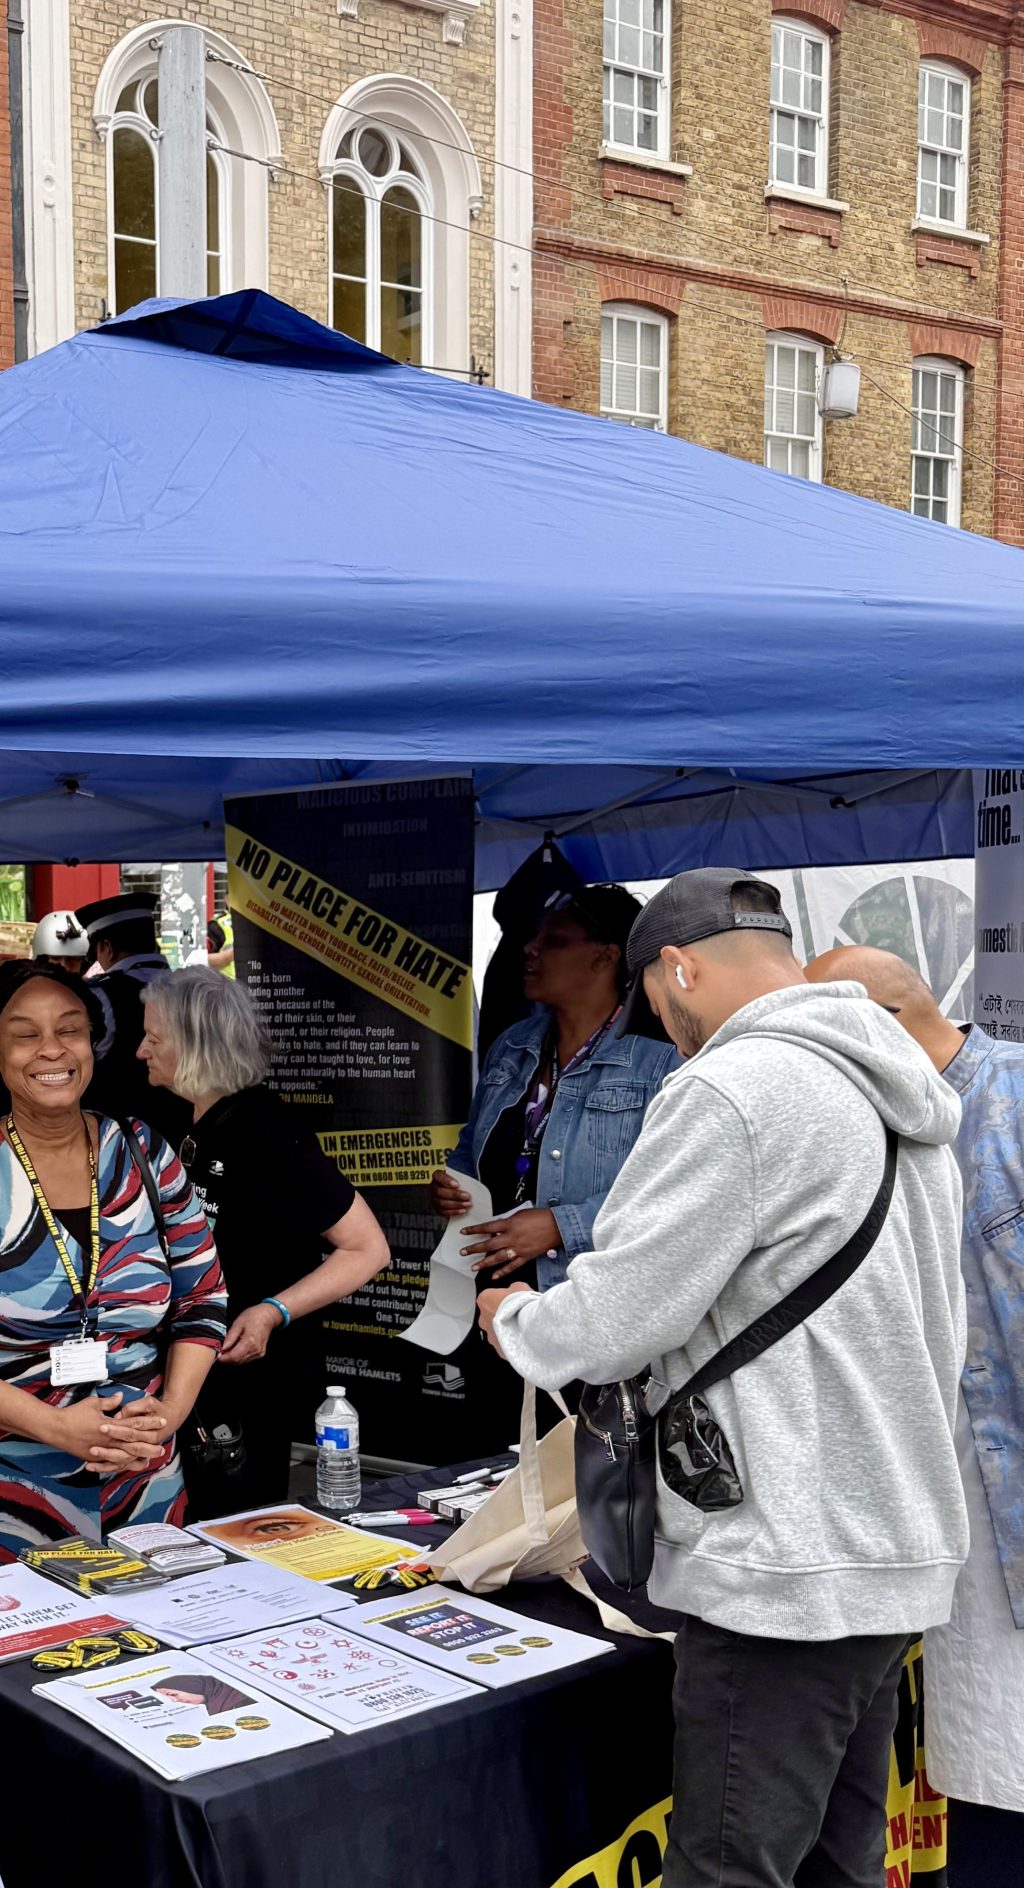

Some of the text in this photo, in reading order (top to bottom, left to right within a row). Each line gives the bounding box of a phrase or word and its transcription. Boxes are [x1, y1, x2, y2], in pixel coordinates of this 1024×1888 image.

[235, 838, 468, 999] NO PLACE FOR HATE
[308, 920, 329, 940] WHAT
[248, 973, 292, 983] one is born
[273, 987, 305, 996] another
[276, 1001, 310, 1010] because
[313, 1000, 321, 1009] of
[322, 1000, 335, 1009] the
[274, 1014, 283, 1023] of
[285, 1013, 303, 1023] their
[326, 1015, 335, 1023] or
[337, 1013, 356, 1023] their
[299, 1029, 308, 1037] or
[310, 1027, 328, 1036] their
[330, 1026, 363, 1038] religion.
[366, 1026, 395, 1037] People
[293, 1041, 301, 1049] to
[325, 1041, 340, 1050] and
[349, 1041, 368, 1052] they
[369, 1042, 385, 1050] can
[387, 1041, 409, 1050] learn
[411, 1041, 420, 1051] to
[290, 1055, 305, 1063] can
[307, 1054, 317, 1063] be
[319, 1055, 344, 1065] taught
[346, 1055, 354, 1064] to
[378, 1055, 390, 1064] for
[392, 1055, 411, 1064] love
[277, 1068, 299, 1076] more
[301, 1068, 336, 1079] naturally
[338, 1069, 346, 1077] to
[347, 1068, 361, 1077] the
[362, 1068, 392, 1078] human
[393, 1068, 416, 1079] heart
[268, 1081, 279, 1089] its
[293, 1094, 334, 1104] MANDELA
[323, 1130, 432, 1152] IN EMERGENCIES
[396, 1258, 421, 1270] Tower
[386, 1272, 400, 1282] the
[376, 1285, 389, 1295] out
[391, 1286, 408, 1296] how
[410, 1289, 426, 1300] you
[354, 1296, 370, 1306] and
[372, 1298, 413, 1311] contribute
[376, 1311, 393, 1322] One
[326, 1356, 369, 1368] MAYOR OF
[326, 1363, 402, 1382] TOWER HAMLETS
[21, 1607, 54, 1621] THEM
[56, 1602, 78, 1614] GET
[24, 1614, 51, 1626] WITH
[405, 1616, 430, 1627] SEE
[407, 1617, 455, 1636] REPORT
[429, 1625, 463, 1639] STOP
